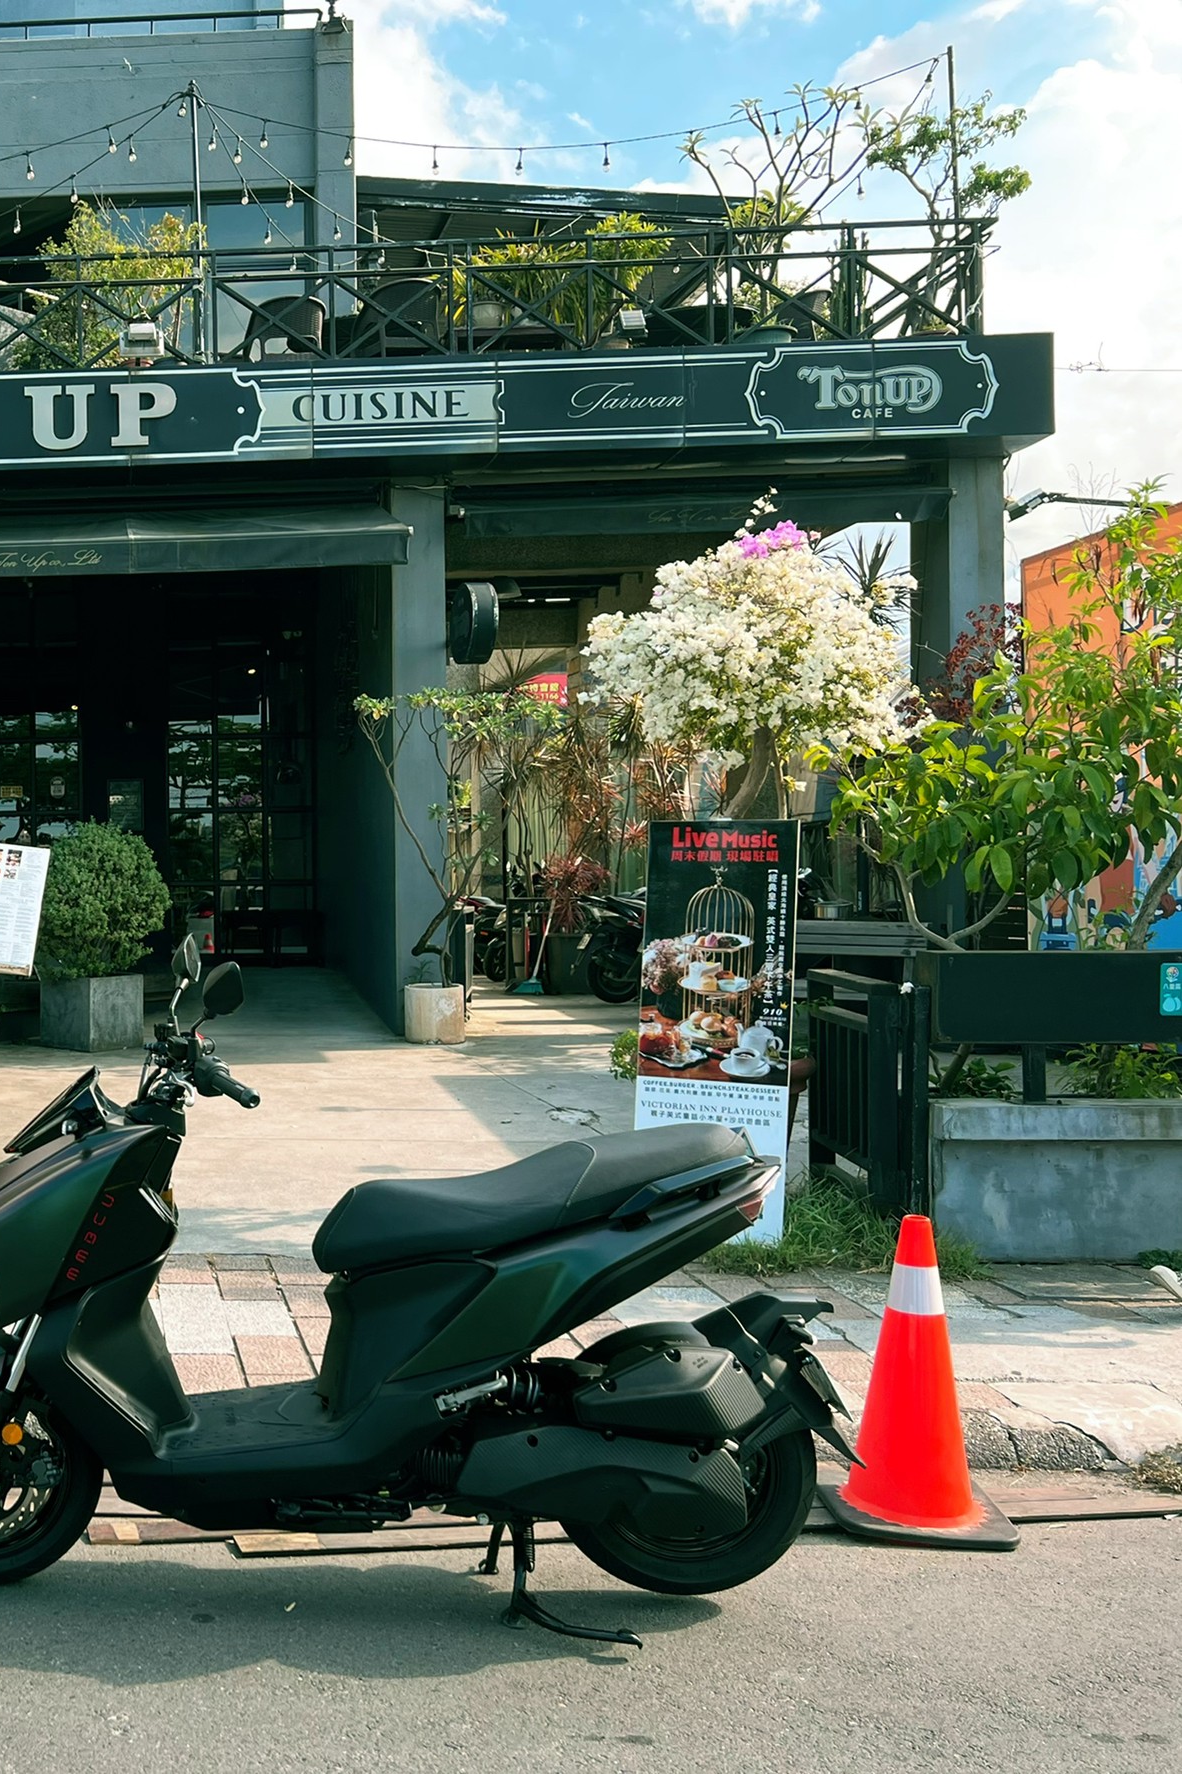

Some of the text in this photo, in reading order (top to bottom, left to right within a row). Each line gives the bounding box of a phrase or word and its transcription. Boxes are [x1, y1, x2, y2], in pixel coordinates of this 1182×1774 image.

[292, 389, 470, 422] CUISINE
[567, 382, 686, 418] Taiwan
[24, 382, 177, 451] UP
[851, 407, 894, 419] CAFE
[672, 827, 777, 848] Live Music
[762, 1008, 783, 1016] 910
[641, 1100, 783, 1119] VICTORIAN INN PLAYHOUSE
